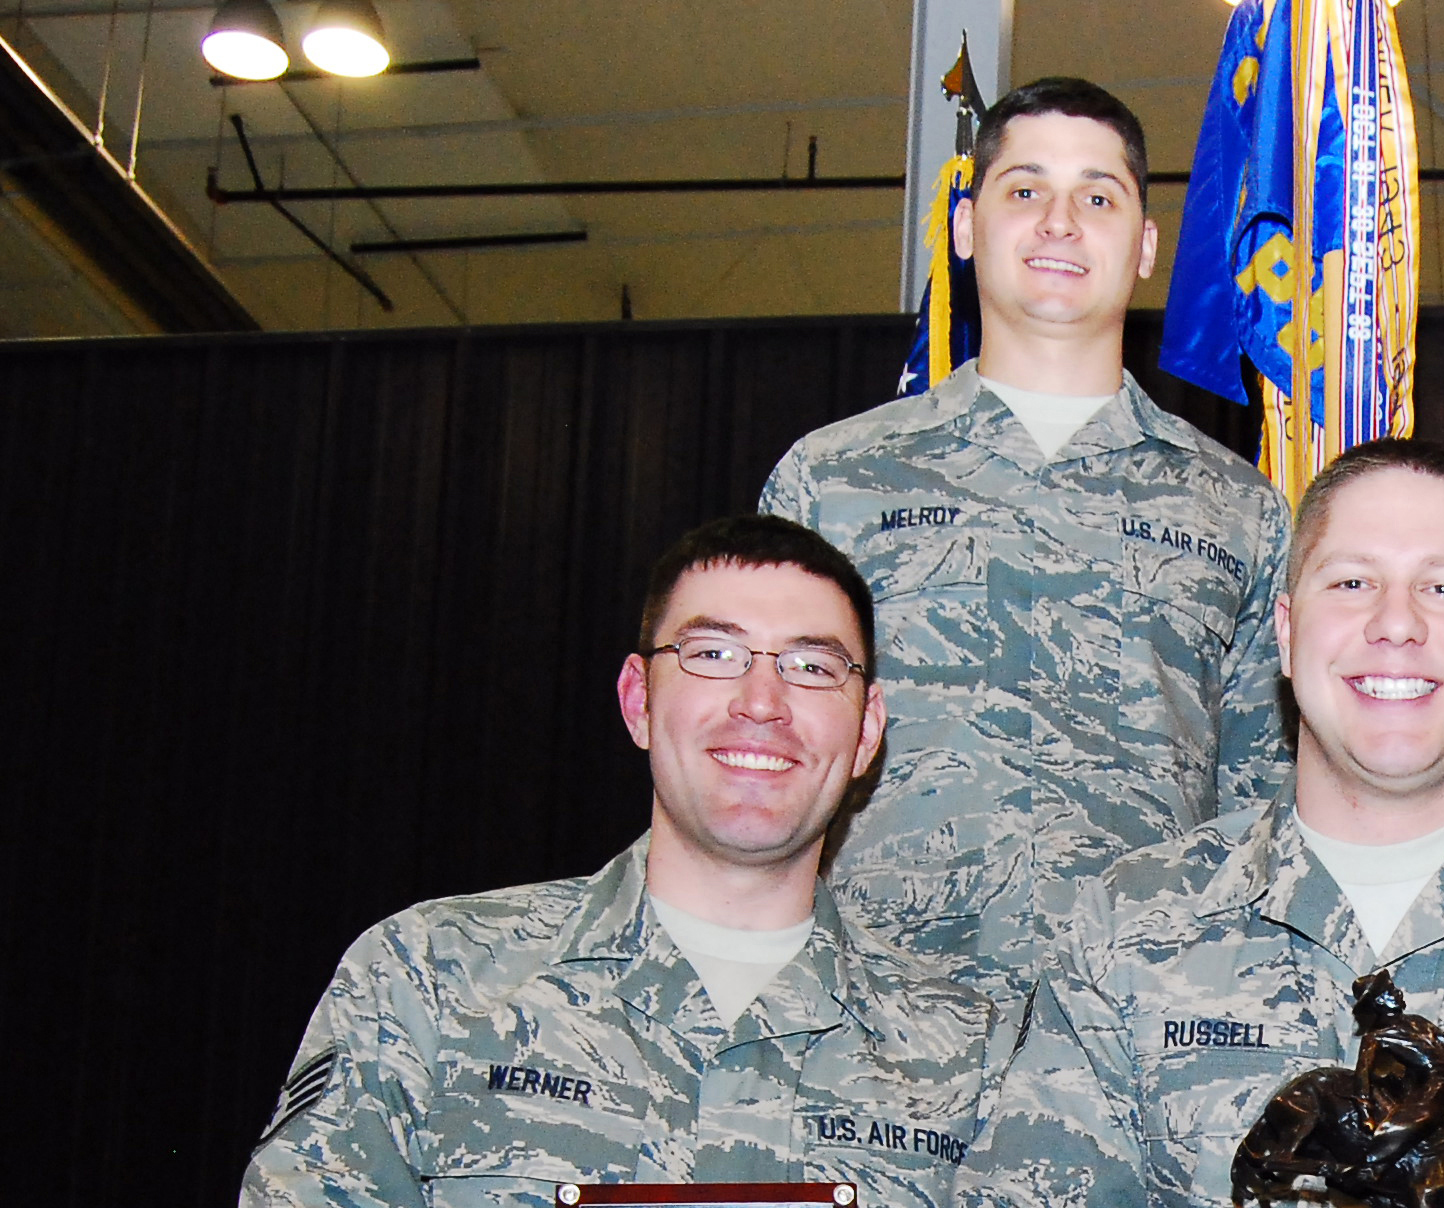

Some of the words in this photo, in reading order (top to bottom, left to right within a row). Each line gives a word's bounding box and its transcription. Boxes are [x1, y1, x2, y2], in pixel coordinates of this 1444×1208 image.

[880, 506, 961, 531] MELROY
[1122, 517, 1156, 543] U.S.
[1160, 527, 1192, 553] AIR
[1199, 538, 1245, 582] FORCE
[1163, 1020, 1270, 1049] RUSSELL
[487, 1064, 592, 1105] WERNER
[819, 1115, 862, 1144] U.S.
[868, 1120, 908, 1151] AIR
